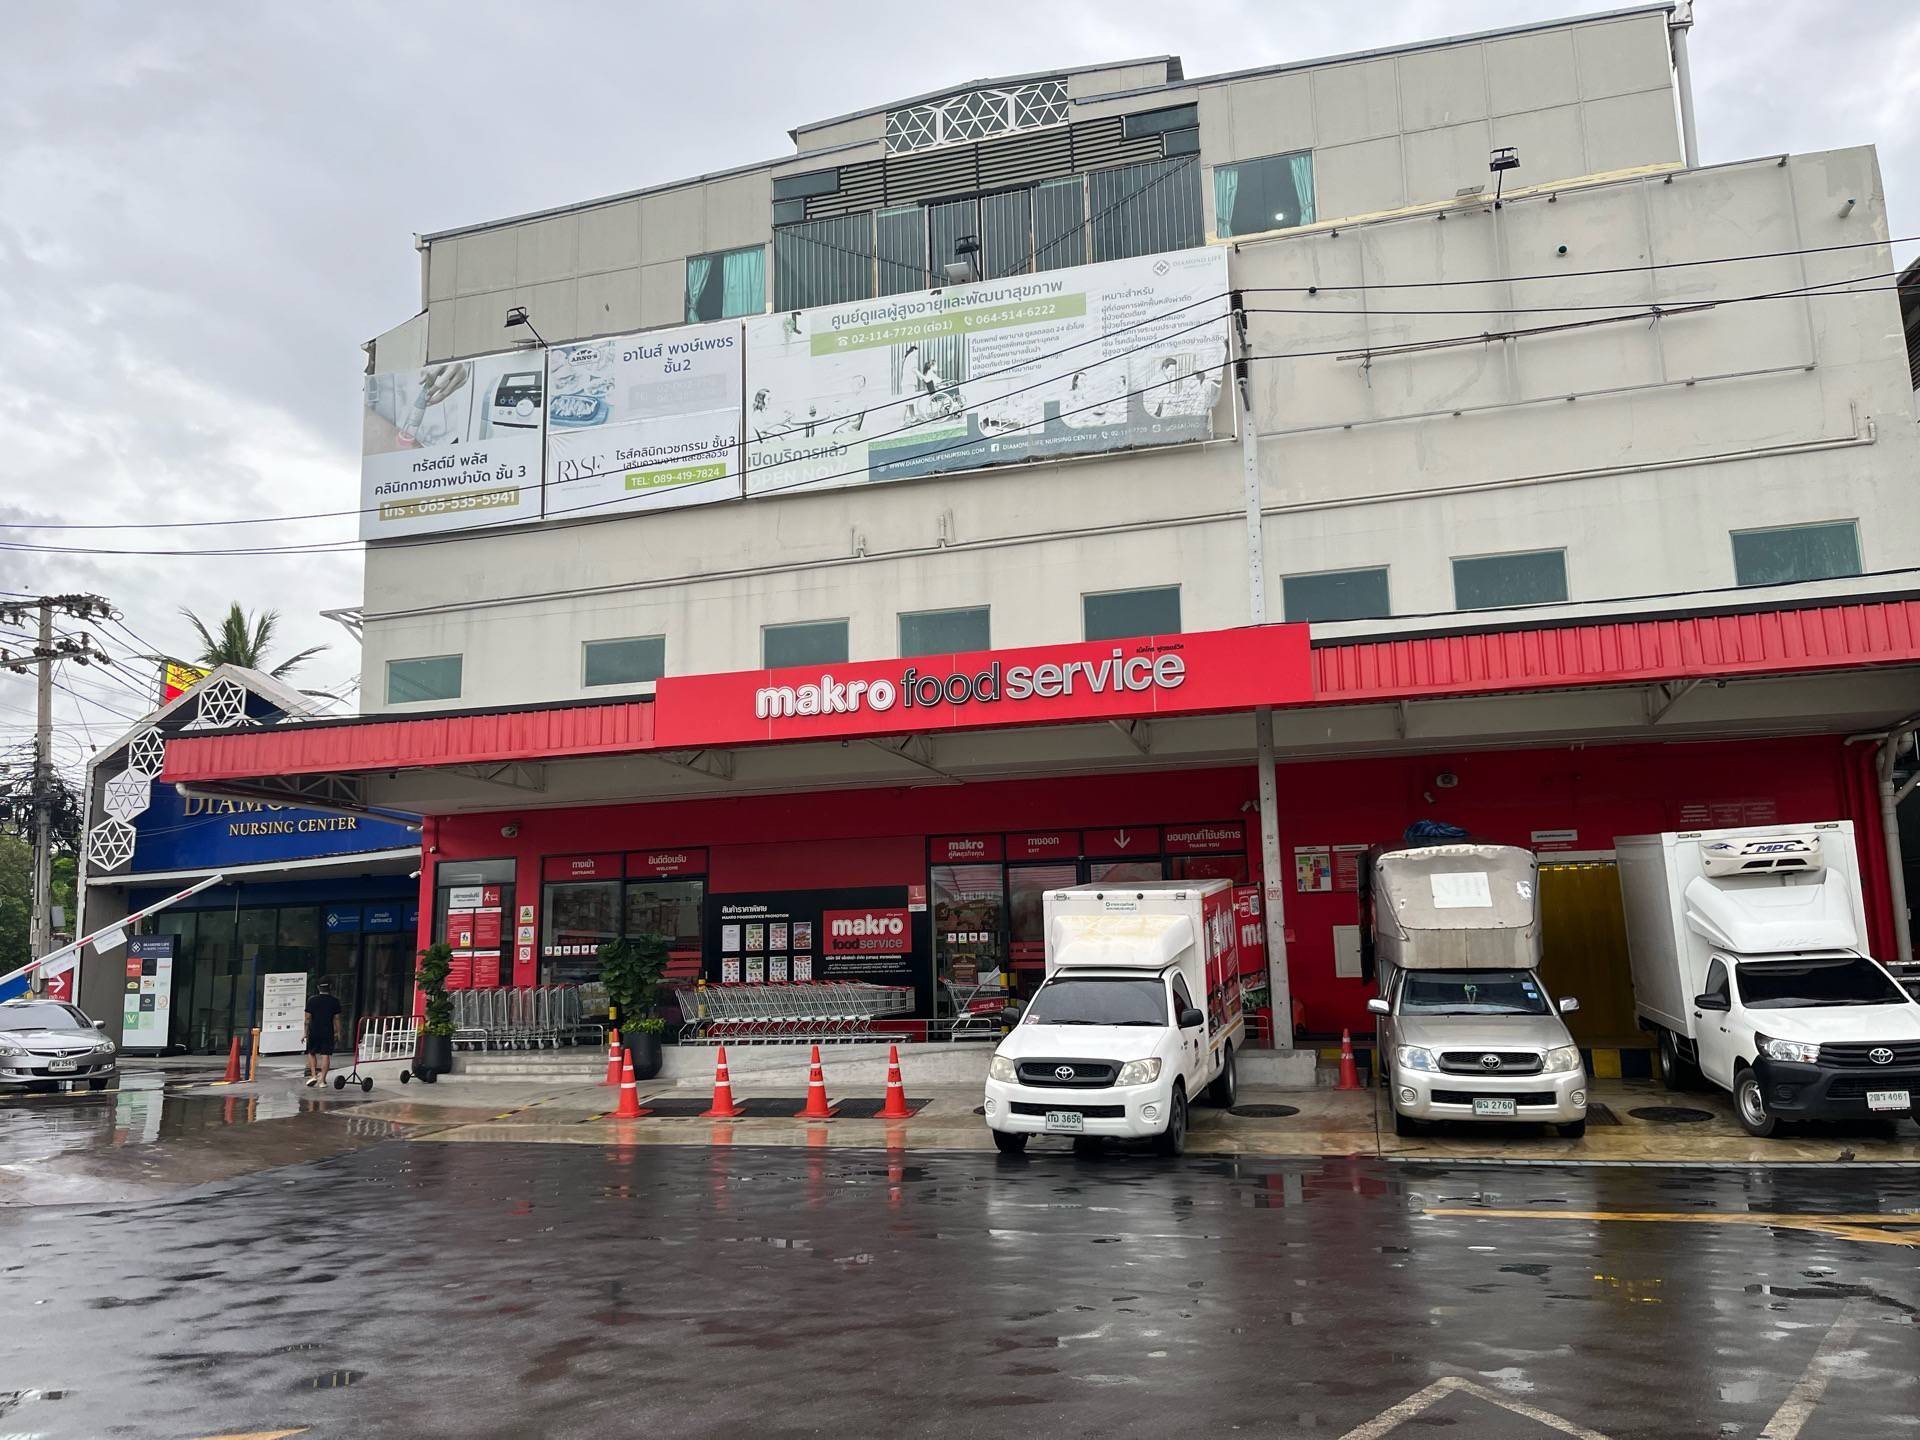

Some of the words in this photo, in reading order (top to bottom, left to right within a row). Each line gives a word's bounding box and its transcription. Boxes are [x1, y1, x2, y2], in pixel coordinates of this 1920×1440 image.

[975, 304, 1056, 325] 064-514-6222
[851, 325, 921, 344] 02-114-7720
[623, 343, 663, 363] อาโนส์
[668, 336, 734, 355] พงษ์เพชร
[663, 358, 682, 374] ชั้น
[682, 359, 691, 371] 2
[616, 440, 708, 461] ไรส์คลินิกเวชกรรม
[711, 436, 728, 450] ชั้น
[728, 435, 736, 448] 3
[1045, 435, 1072, 446] NURSING
[1073, 432, 1098, 443] CENTER
[412, 455, 456, 473] ทรัสต์มี
[460, 452, 488, 468] พลัส
[746, 442, 848, 468] เปิดบริการแล้ว
[374, 469, 491, 495] คลินิกกายภาพบำบัด
[495, 466, 514, 482] ชั้น
[517, 465, 527, 479] 3
[632, 475, 651, 488] TEL:
[653, 468, 720, 485] 089-419-7824
[418, 489, 516, 514] 065-535-5941
[755, 673, 896, 720] makro
[229, 821, 293, 837] NURSING
[298, 816, 357, 833] CENTER
[1167, 828, 1241, 842] ขอบคุณที่ใช้บริการ
[948, 839, 984, 851] makro
[1027, 836, 1060, 846] ทางออก
[1755, 843, 1796, 853] MPC
[572, 858, 594, 869] ทางเข้า
[648, 853, 687, 865] ยินดีต้อนรับ
[831, 913, 904, 937] makro
[1491, 1101, 1513, 1110] 2760
[1061, 1114, 1082, 1124] 3656
